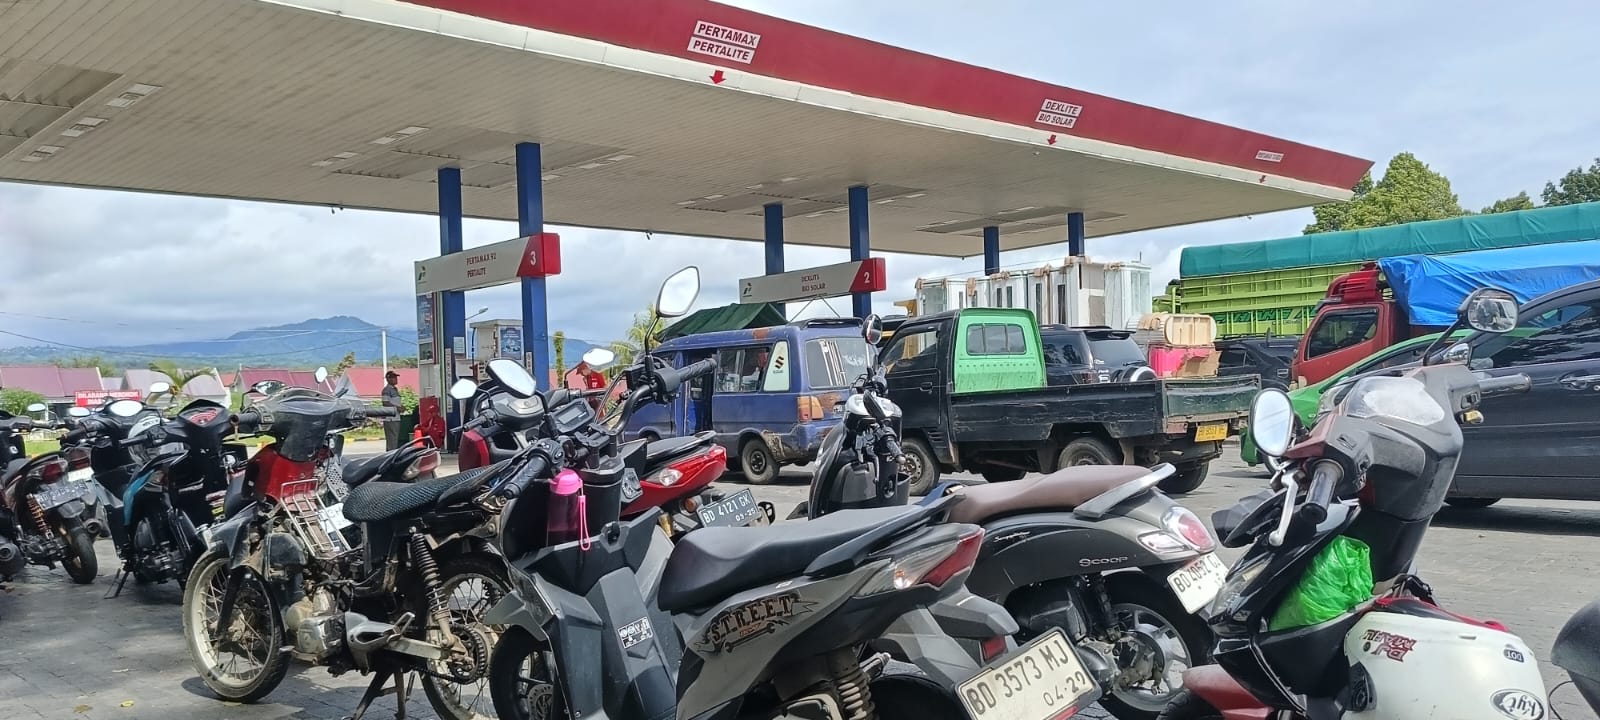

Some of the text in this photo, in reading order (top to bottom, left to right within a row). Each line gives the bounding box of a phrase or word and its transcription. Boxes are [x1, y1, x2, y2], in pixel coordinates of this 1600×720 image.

[698, 23, 757, 46] PERTAMAX
[693, 39, 750, 60] PERTALITE
[1045, 101, 1079, 114] DEXLITE
[1038, 113, 1073, 126] BIO SOLAR
[530, 250, 536, 266] 3
[863, 271, 870, 284] 2
[702, 493, 751, 524] BD 4121 GK
[1173, 573, 1192, 593] BD
[1506, 650, 1523, 661] DOT
[966, 639, 1069, 716] BD 3573 MJ
